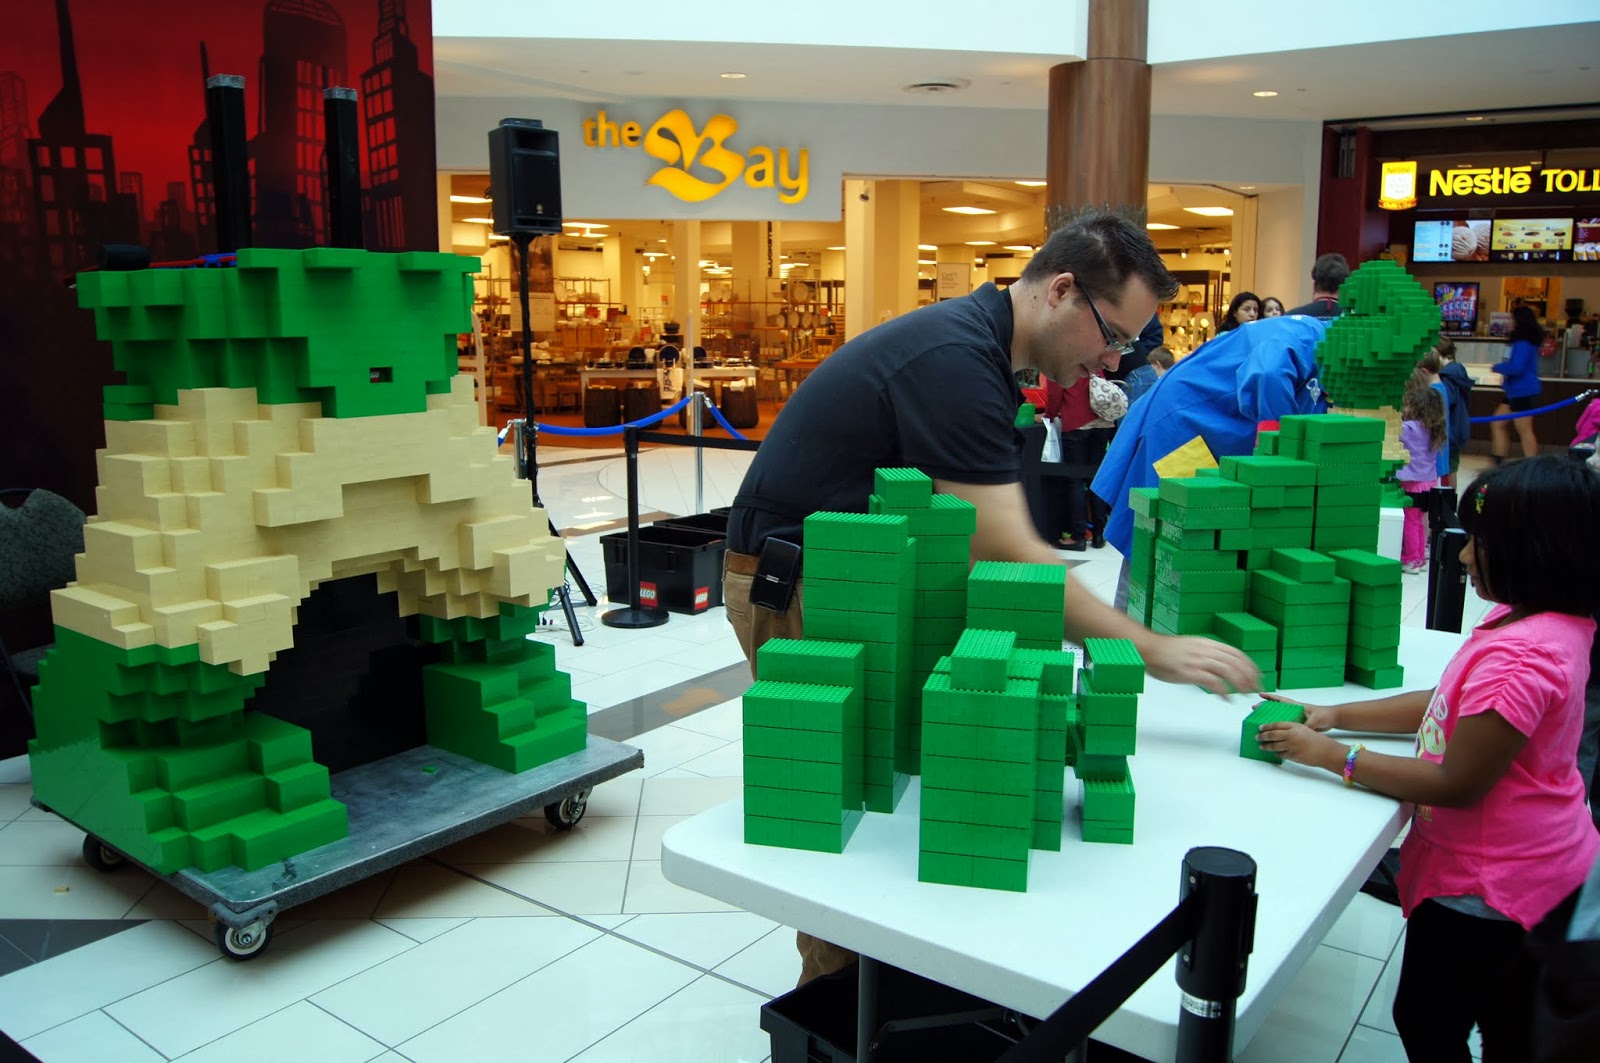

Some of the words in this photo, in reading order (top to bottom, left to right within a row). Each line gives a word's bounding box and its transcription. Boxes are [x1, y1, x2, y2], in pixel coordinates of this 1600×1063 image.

[581, 110, 642, 148] the
[643, 109, 809, 204] Bay
[1429, 165, 1532, 196] Nestlé
[640, 588, 655, 599] LEGO
